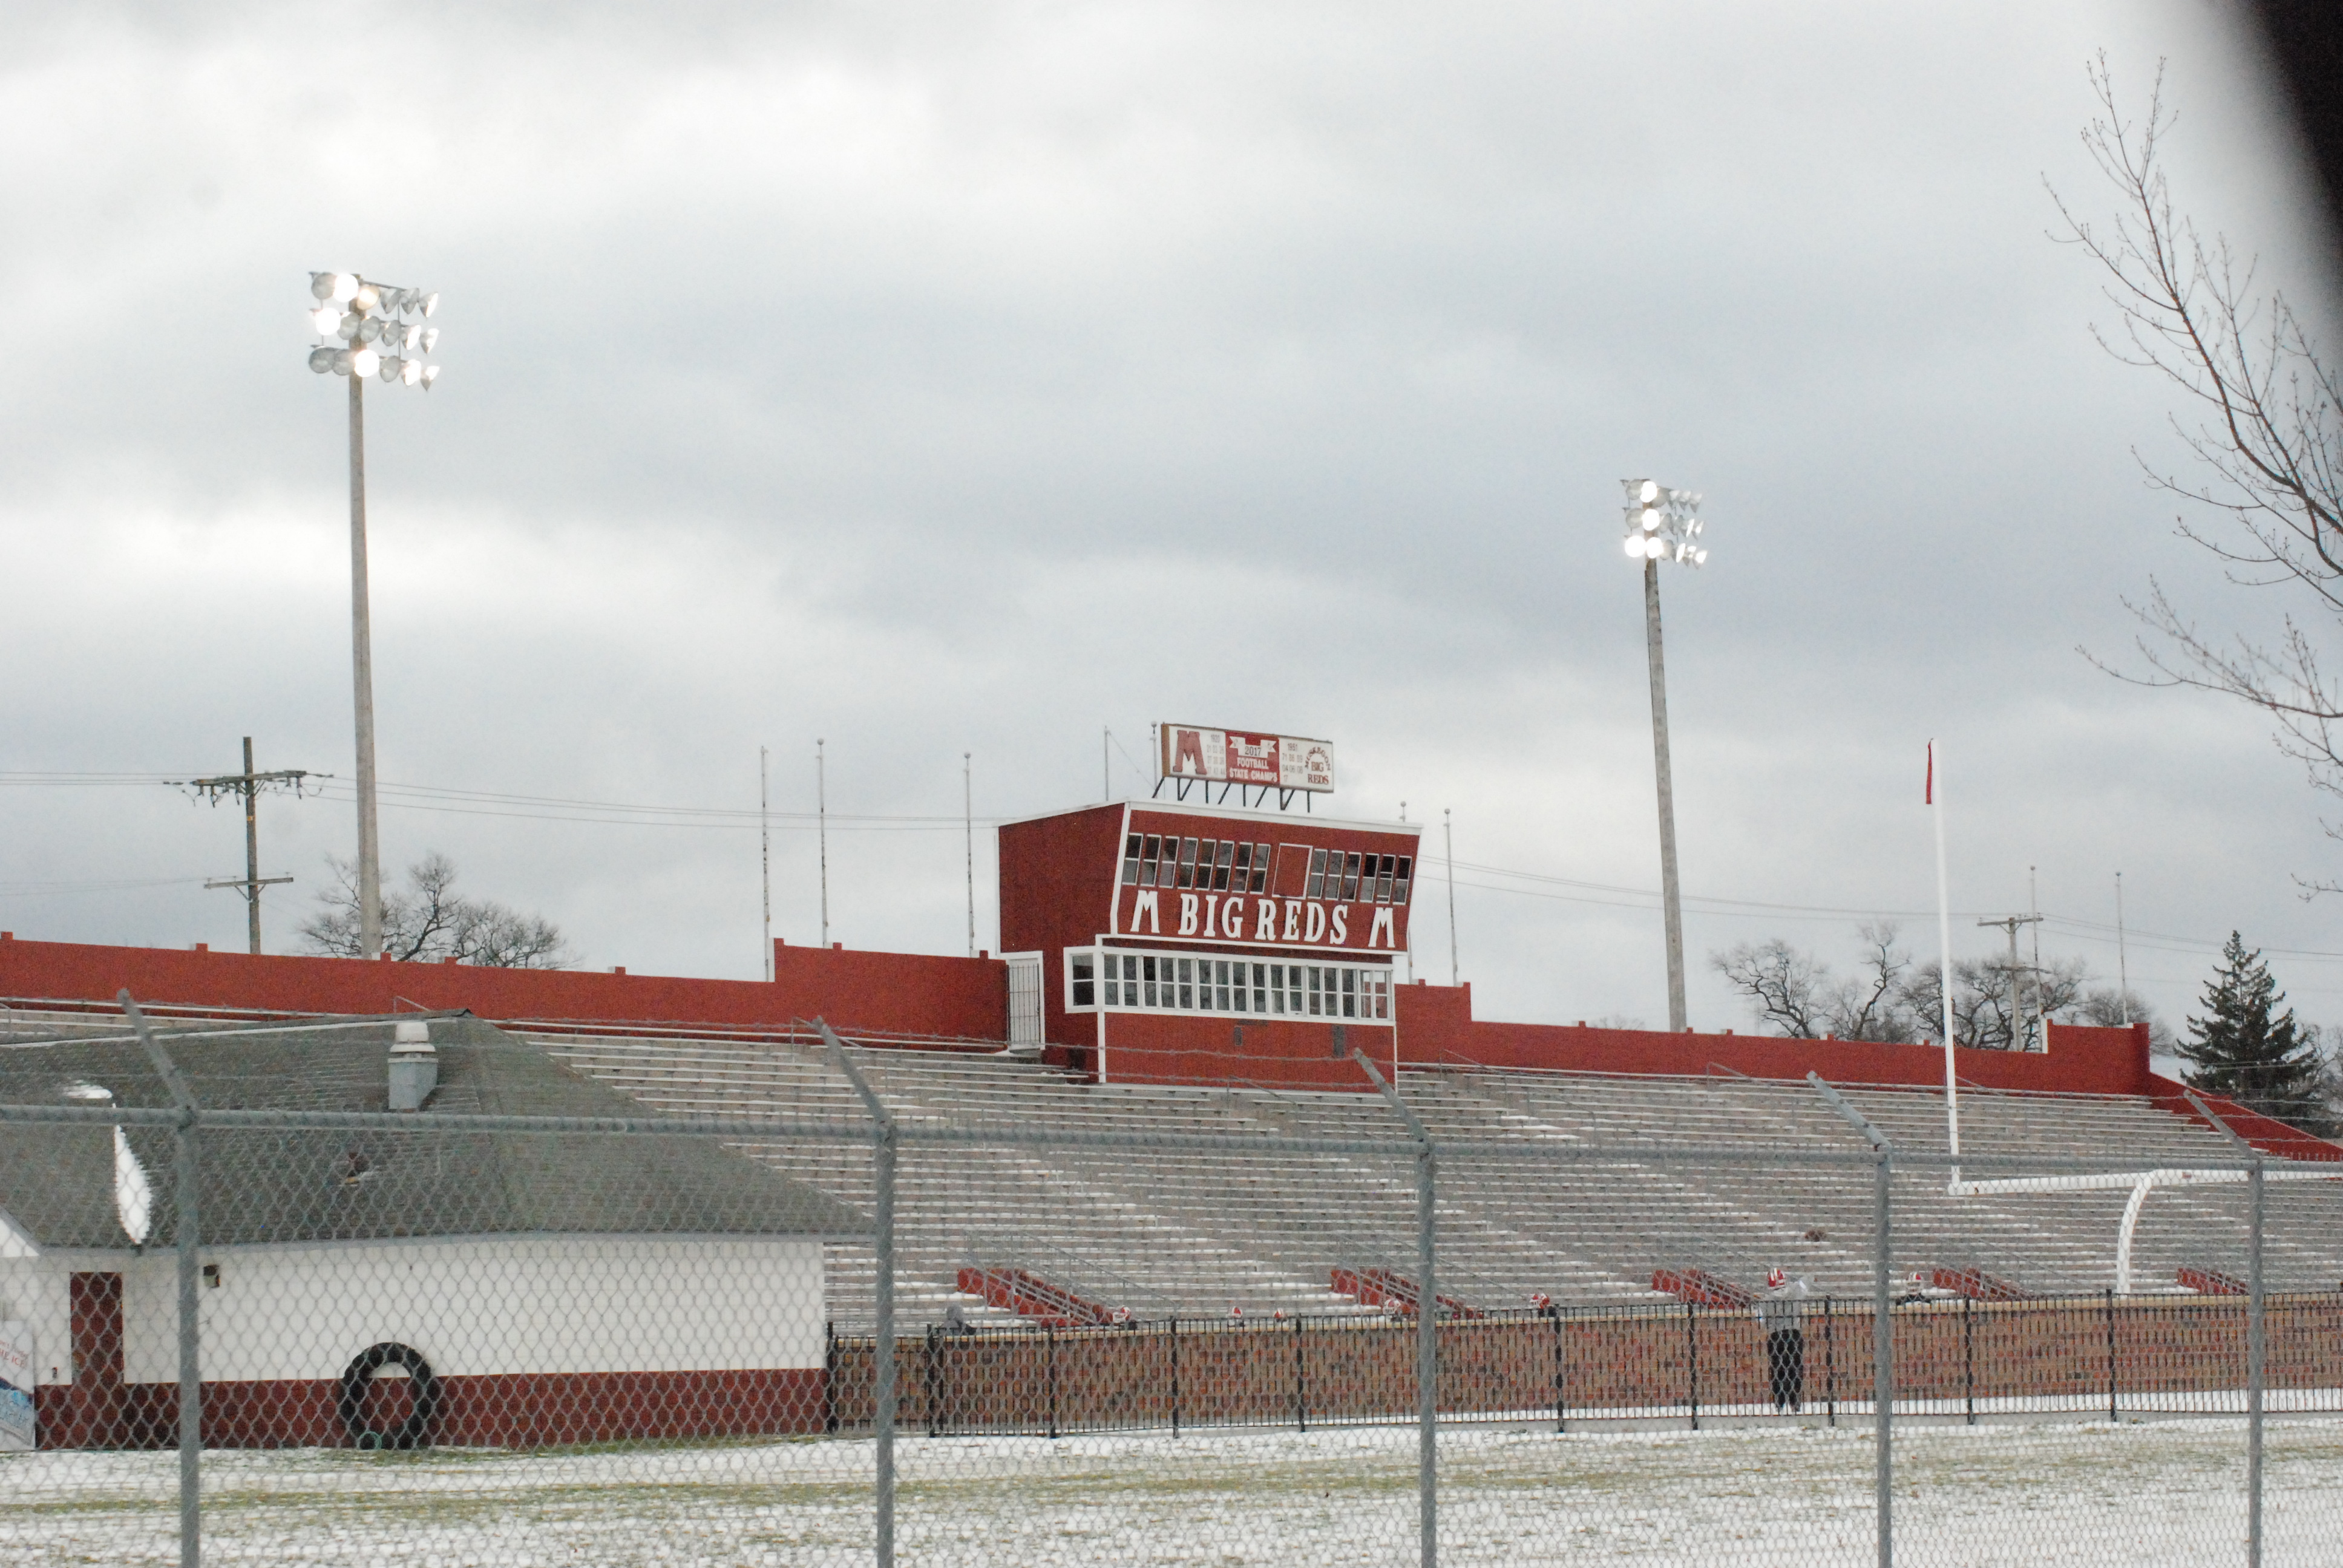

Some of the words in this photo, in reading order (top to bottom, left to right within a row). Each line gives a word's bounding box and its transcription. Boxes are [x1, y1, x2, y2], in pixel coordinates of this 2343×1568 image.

[1173, 730, 1207, 774] M
[1245, 746, 1261, 756] 2017
[1237, 757, 1269, 769] FOOTBALL
[1305, 747, 1331, 771] MUSKEGON
[1311, 762, 1324, 772] BIG
[1229, 767, 1248, 779] STATE
[1251, 770, 1278, 783] CHAMPS
[1308, 774, 1329, 785] REDS
[1130, 890, 1160, 933] M
[1178, 893, 1244, 939] BIG
[1254, 898, 1349, 944] REDS
[1368, 907, 1395, 948] M
